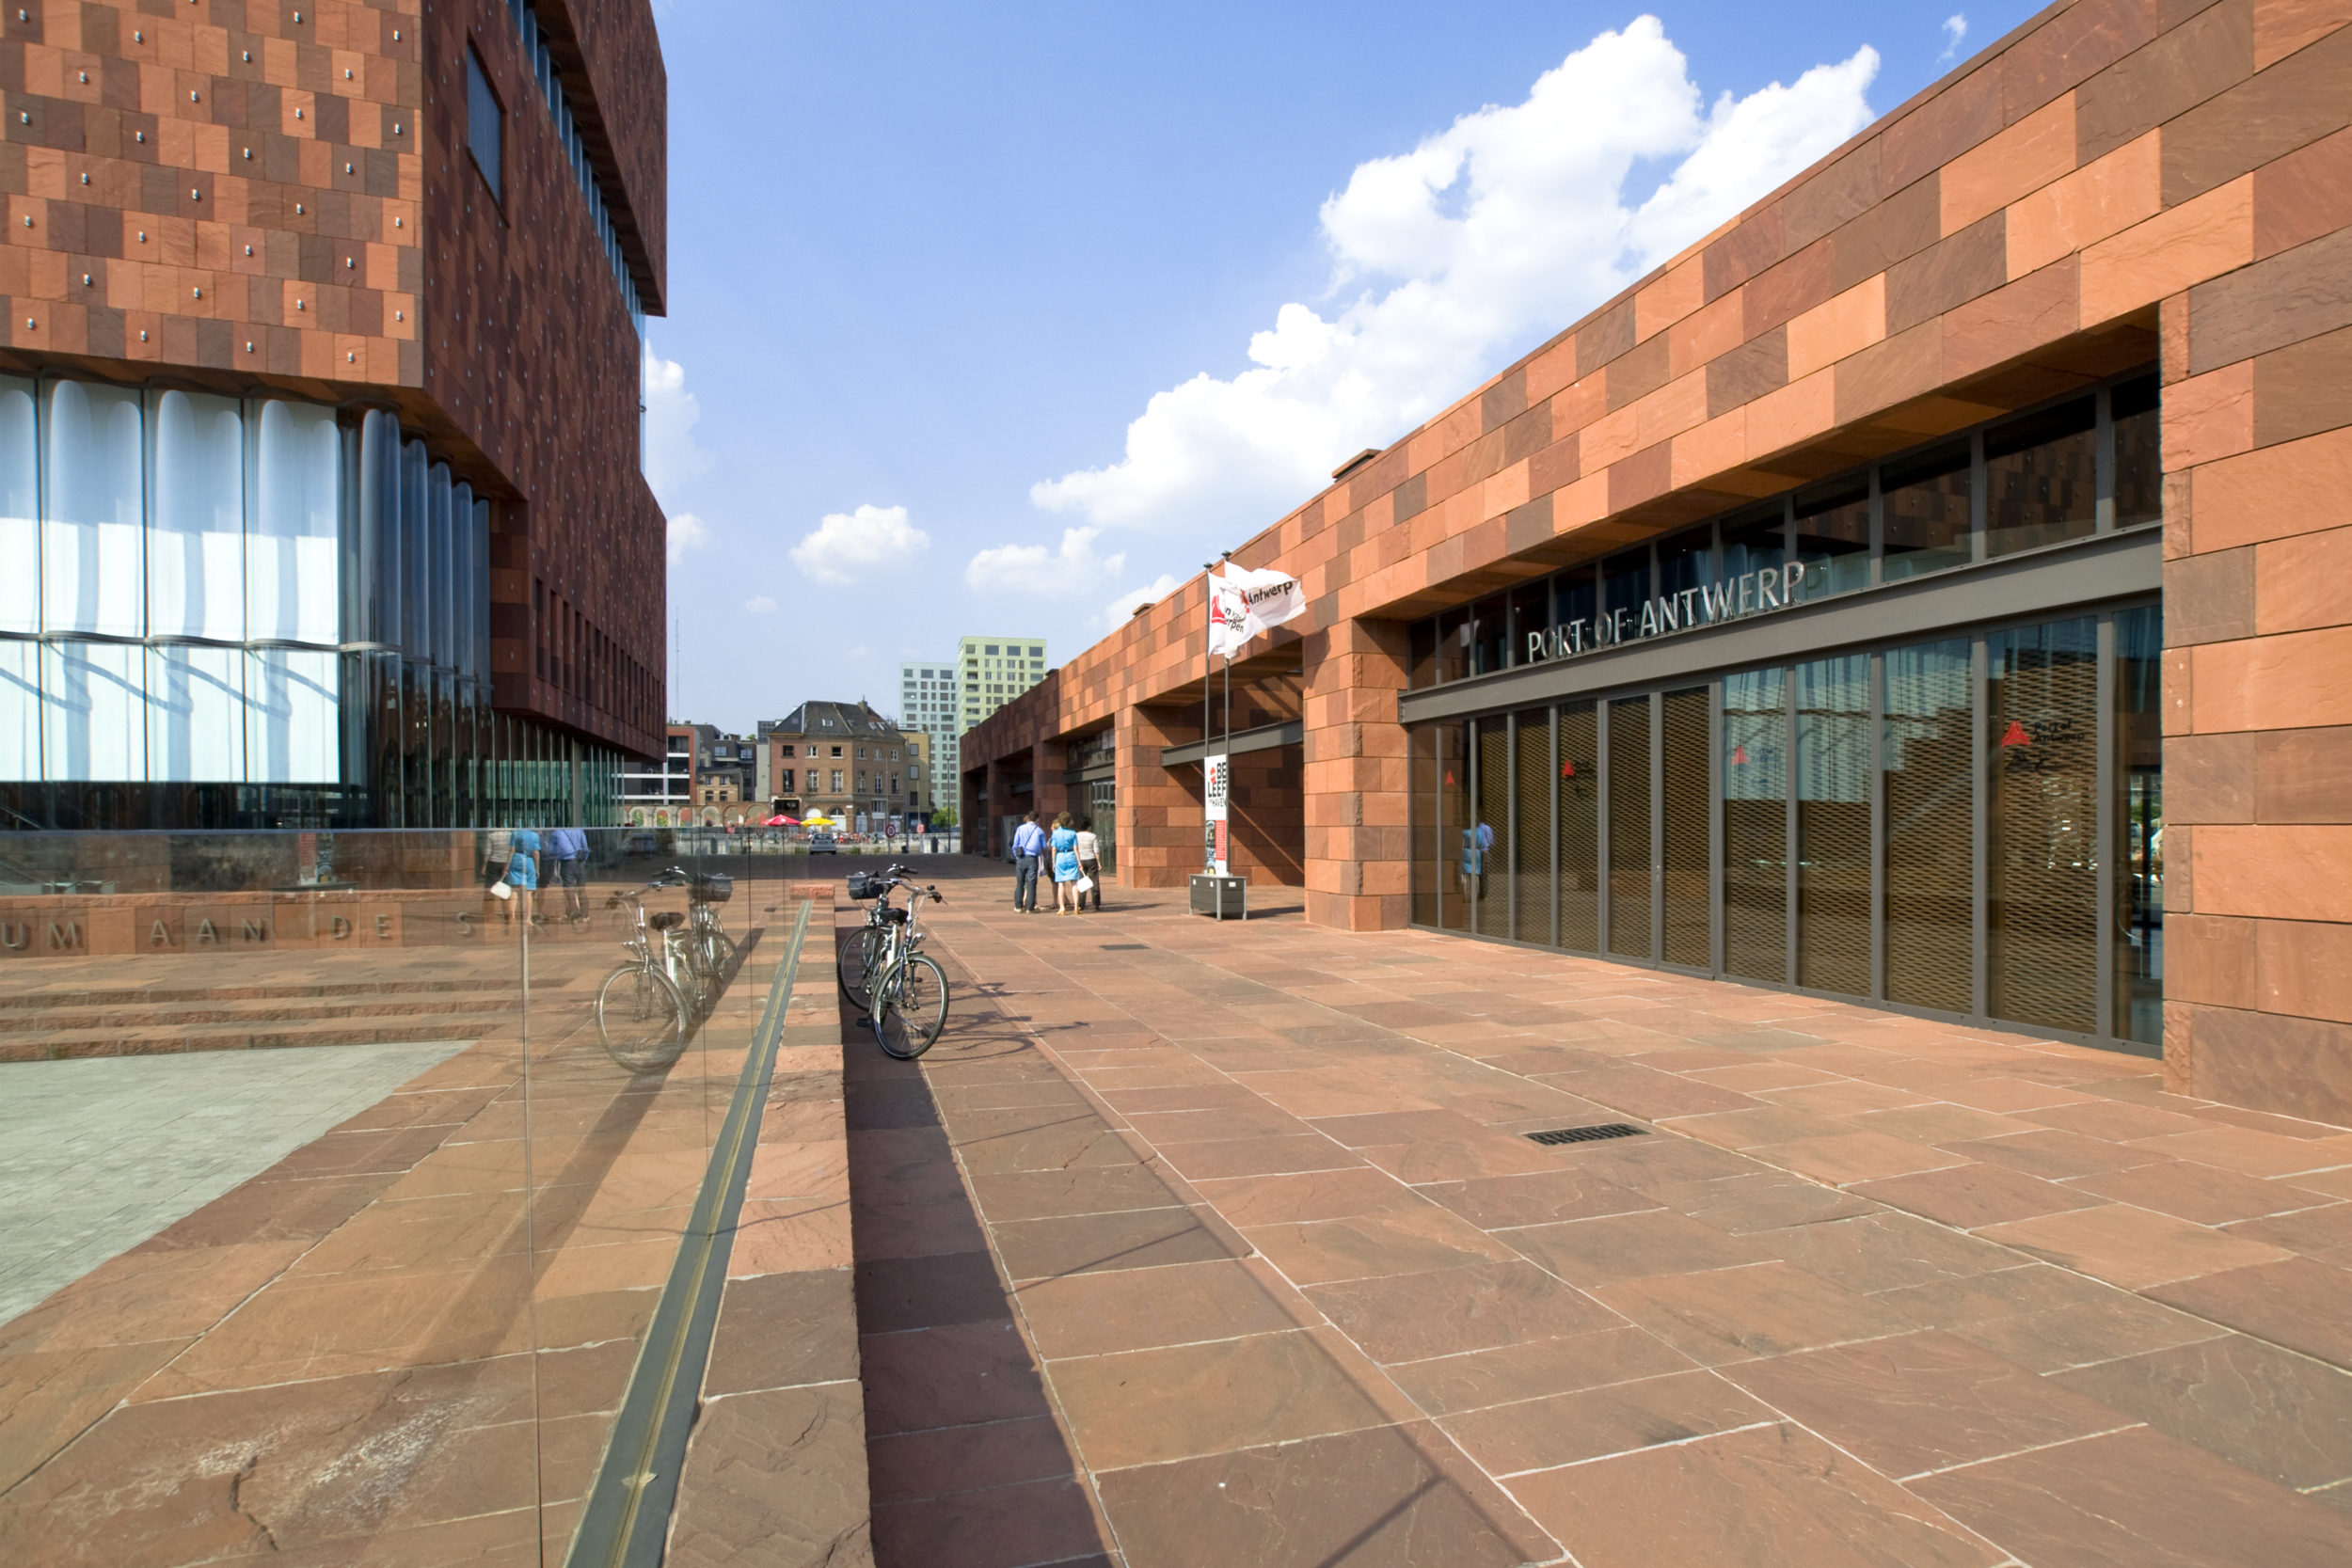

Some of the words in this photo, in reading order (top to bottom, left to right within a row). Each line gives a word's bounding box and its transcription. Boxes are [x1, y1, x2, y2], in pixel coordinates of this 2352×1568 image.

[1248, 580, 1294, 606] Antwerp
[1528, 618, 1586, 663] PORT
[1595, 607, 1628, 646] OF
[1640, 561, 1804, 637] ANTWERP
[1216, 762, 1227, 779] BE
[1208, 780, 1227, 798] LEEF
[149, 917, 264, 943] AAN
[331, 912, 393, 940] DE
